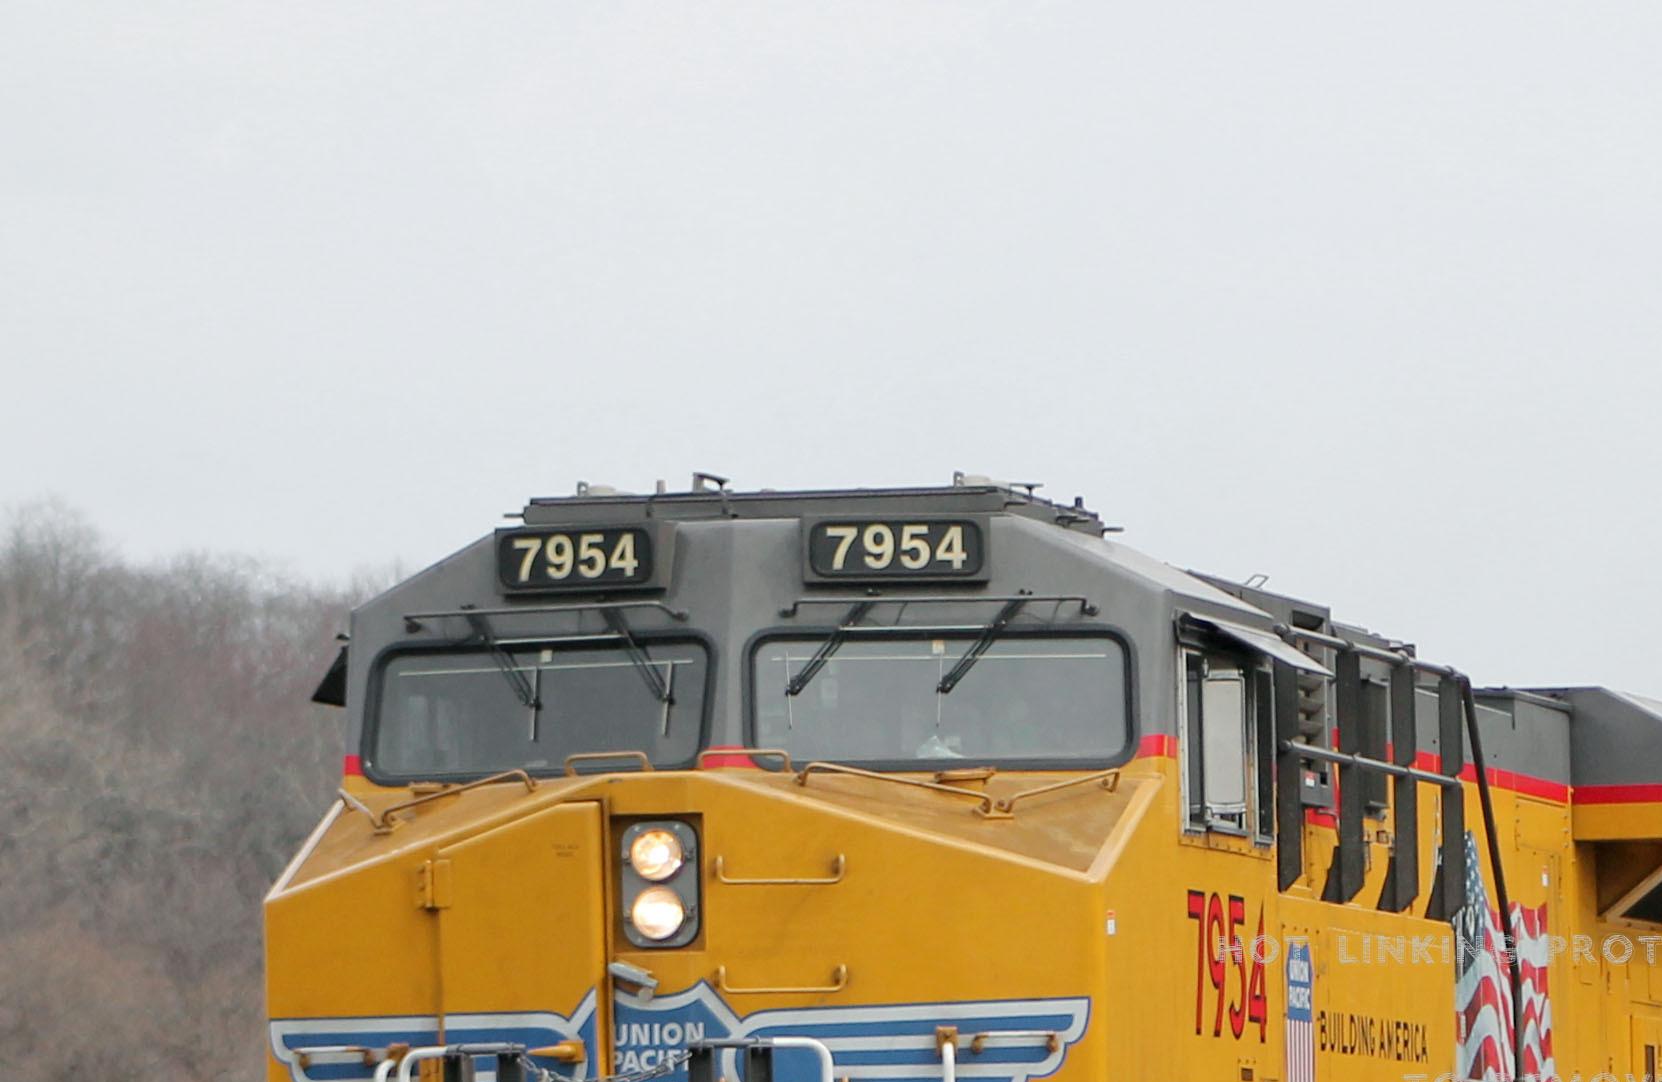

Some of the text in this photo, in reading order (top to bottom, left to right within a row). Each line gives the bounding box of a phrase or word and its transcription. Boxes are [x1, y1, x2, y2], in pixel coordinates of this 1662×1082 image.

[512, 533, 639, 582] 7954
[826, 524, 968, 571] 7954
[1187, 888, 1268, 1044] 7954
[615, 1022, 705, 1047] UNION
[1320, 1010, 1429, 1064] BUILDING AMERICA
